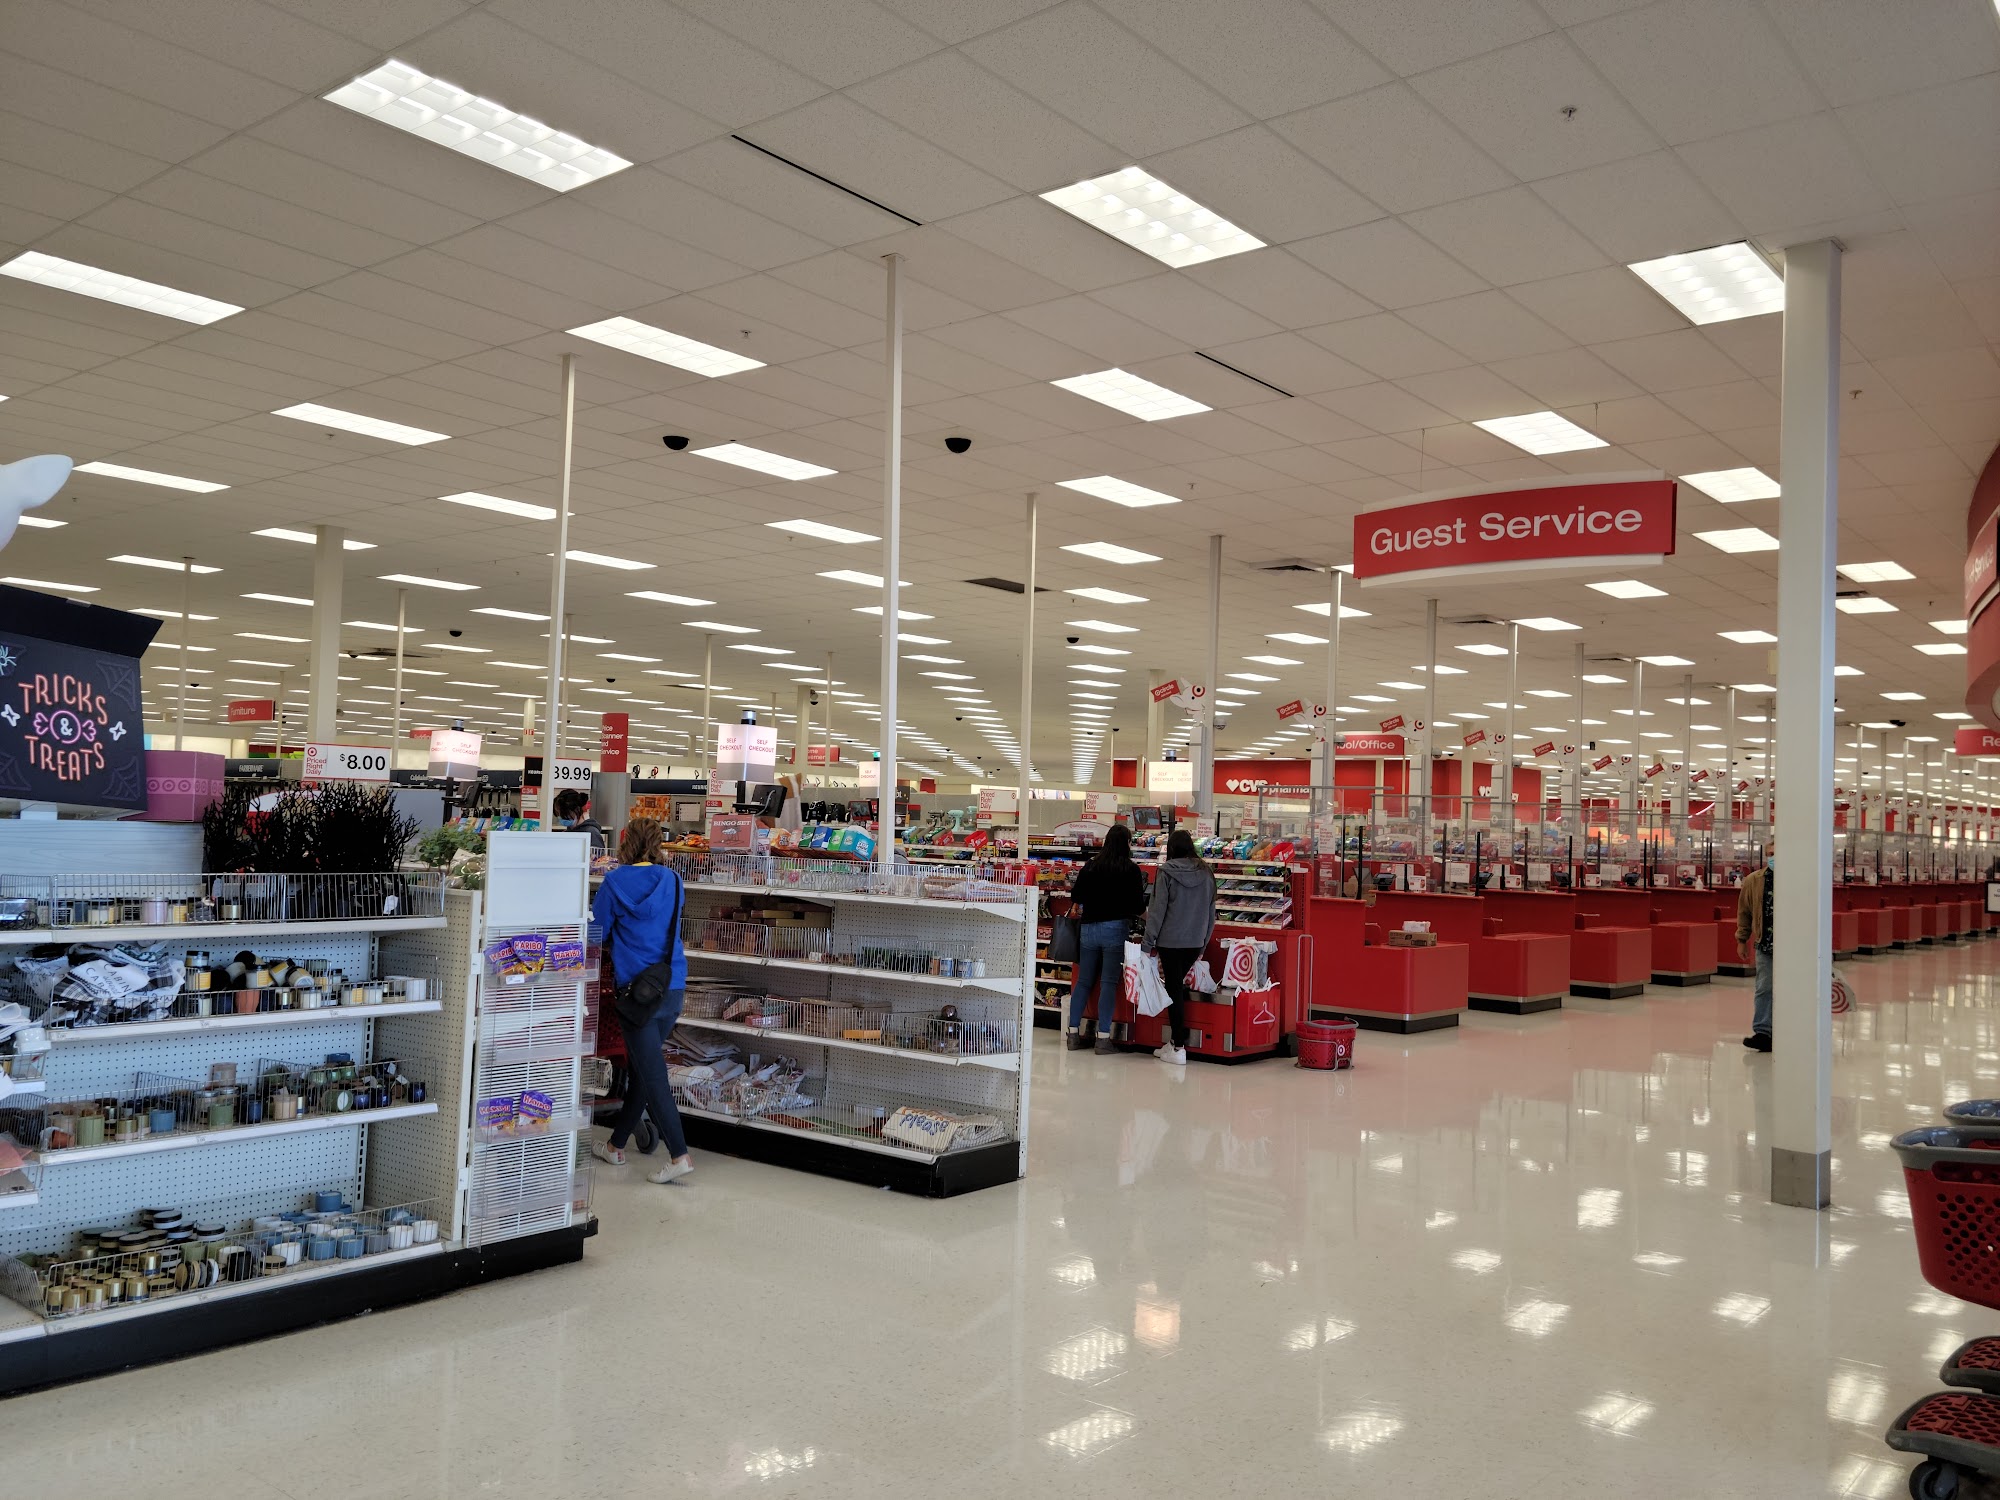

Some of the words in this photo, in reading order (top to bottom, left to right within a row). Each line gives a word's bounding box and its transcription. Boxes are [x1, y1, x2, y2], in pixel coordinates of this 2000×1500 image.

[1370, 517, 1466, 556] Guest
[1479, 505, 1643, 541] Service
[18, 673, 108, 725] TRICKS
[230, 707, 256, 716] Furniture
[60, 717, 73, 736] &
[24, 735, 105, 781] TREATS
[452, 748, 478, 756] CHECKOUT
[306, 763, 323, 771] Right
[339, 754, 386, 771] $8.00
[1239, 779, 1268, 793] CVS
[514, 941, 542, 951] HARIBO
[489, 947, 514, 962] HARIB
[553, 949, 580, 960] HARIBO
[103, 963, 132, 993] CABIN
